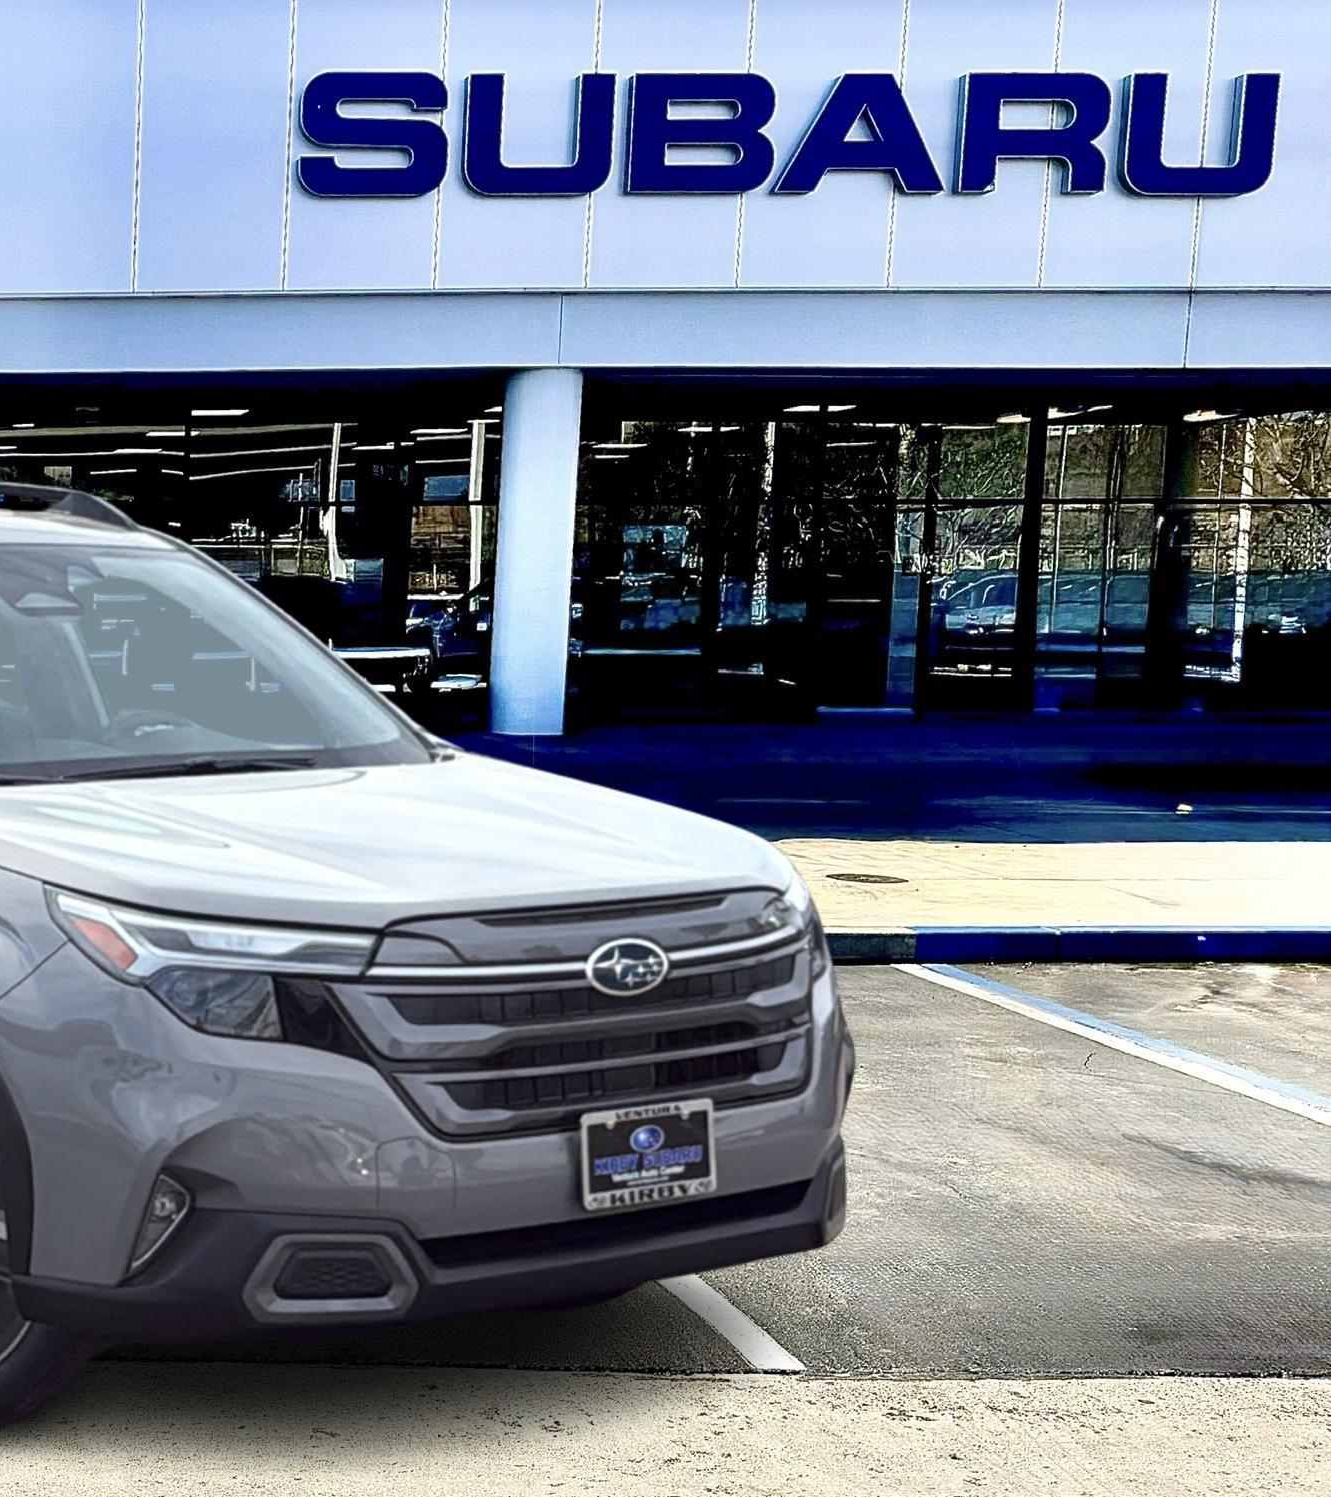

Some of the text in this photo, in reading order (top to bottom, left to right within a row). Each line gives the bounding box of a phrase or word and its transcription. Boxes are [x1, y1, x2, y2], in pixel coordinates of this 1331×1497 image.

[296, 71, 1282, 199] SUBARU
[615, 1105, 682, 1119] VENTURA
[594, 1145, 703, 1175] KIRBY SUBARU
[611, 1184, 689, 1205] KIRBY
